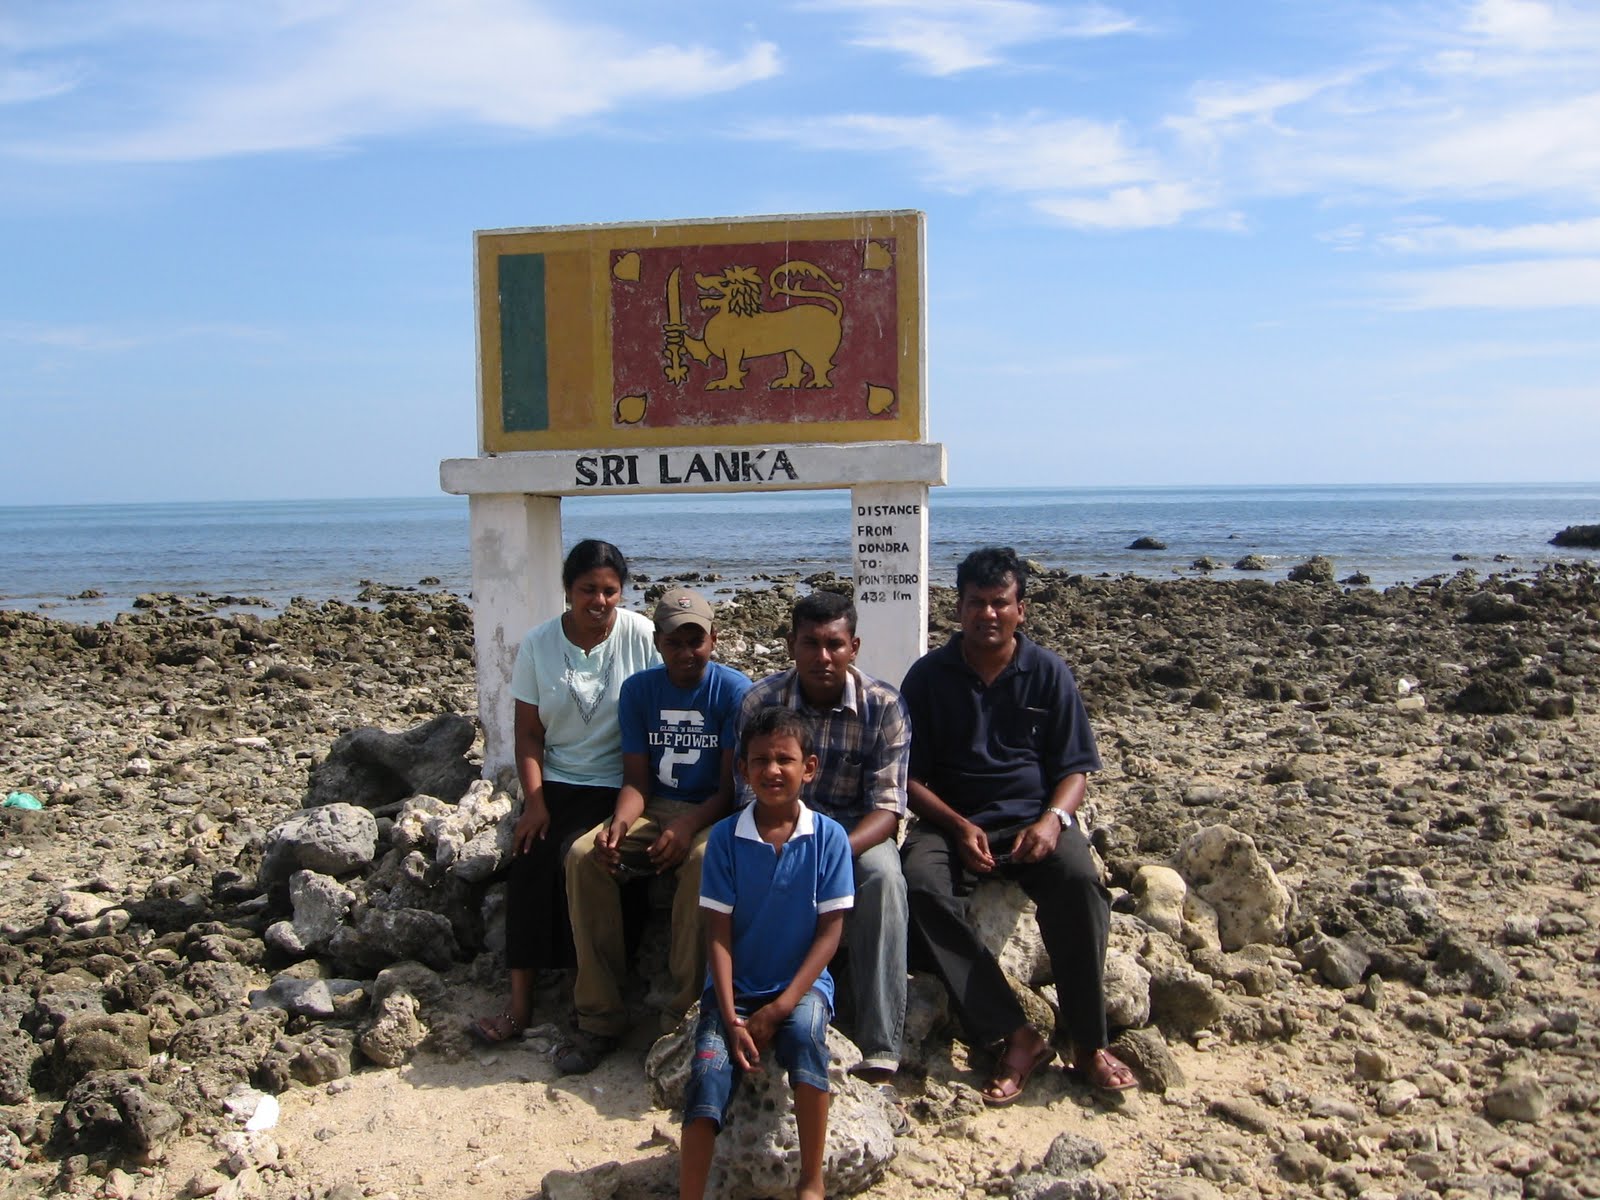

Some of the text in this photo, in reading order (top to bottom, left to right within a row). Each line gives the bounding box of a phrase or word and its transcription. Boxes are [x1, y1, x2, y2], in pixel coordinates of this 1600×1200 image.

[575, 449, 800, 487] SRI LANKA
[857, 505, 920, 517] DISTANCE
[857, 525, 893, 537] FROM
[858, 542, 910, 553] DONDRA
[860, 559, 883, 569] TO:
[860, 591, 887, 603] 432
[674, 733, 719, 748] POWER
